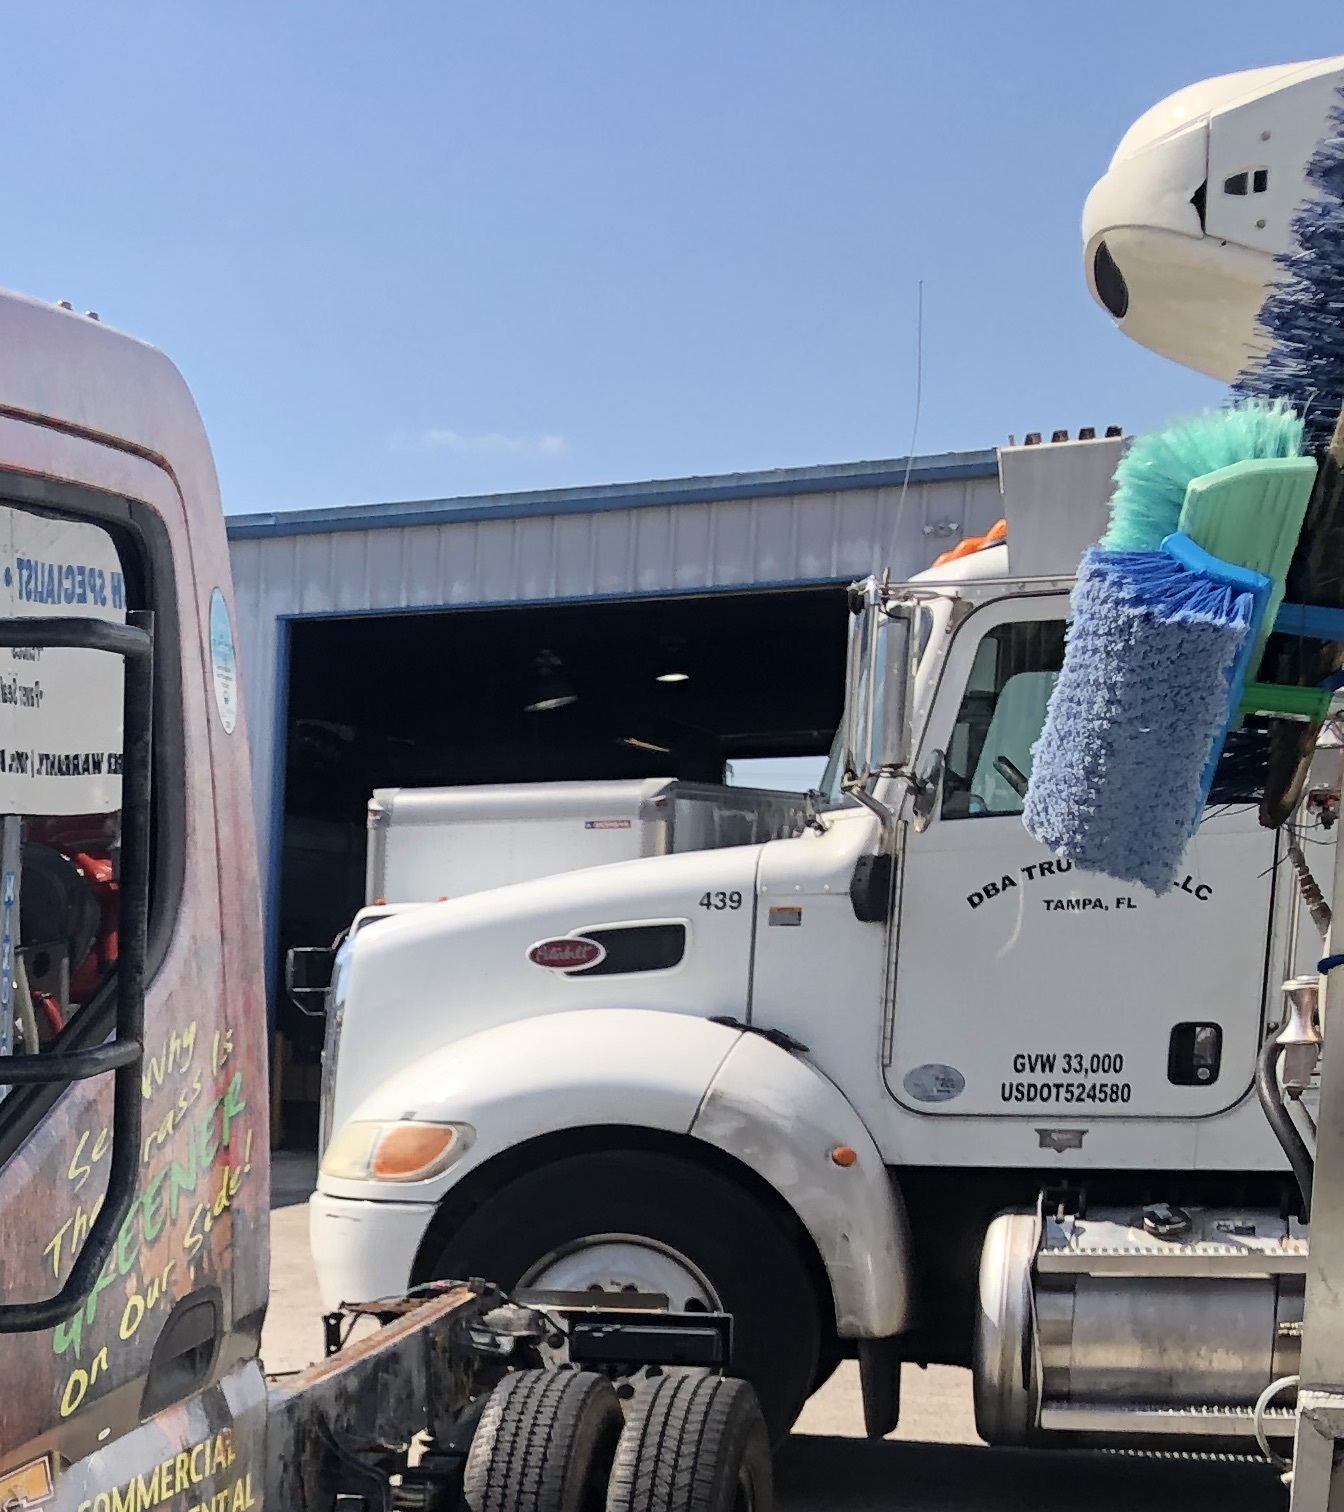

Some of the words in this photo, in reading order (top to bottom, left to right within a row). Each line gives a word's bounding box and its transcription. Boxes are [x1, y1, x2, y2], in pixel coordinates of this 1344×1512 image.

[966, 875, 1017, 909] DBA
[1021, 859, 1072, 880] TRU
[699, 891, 742, 910] 439
[1043, 897, 1109, 911] TAMPA,
[1115, 897, 1137, 909] FL
[1013, 1053, 1057, 1074] GVW
[1062, 1053, 1124, 1078] 33,000
[1001, 1082, 1131, 1103] USDOT524580
[142, 1070, 203, 1163] rass
[68, 1128, 110, 1193] Se
